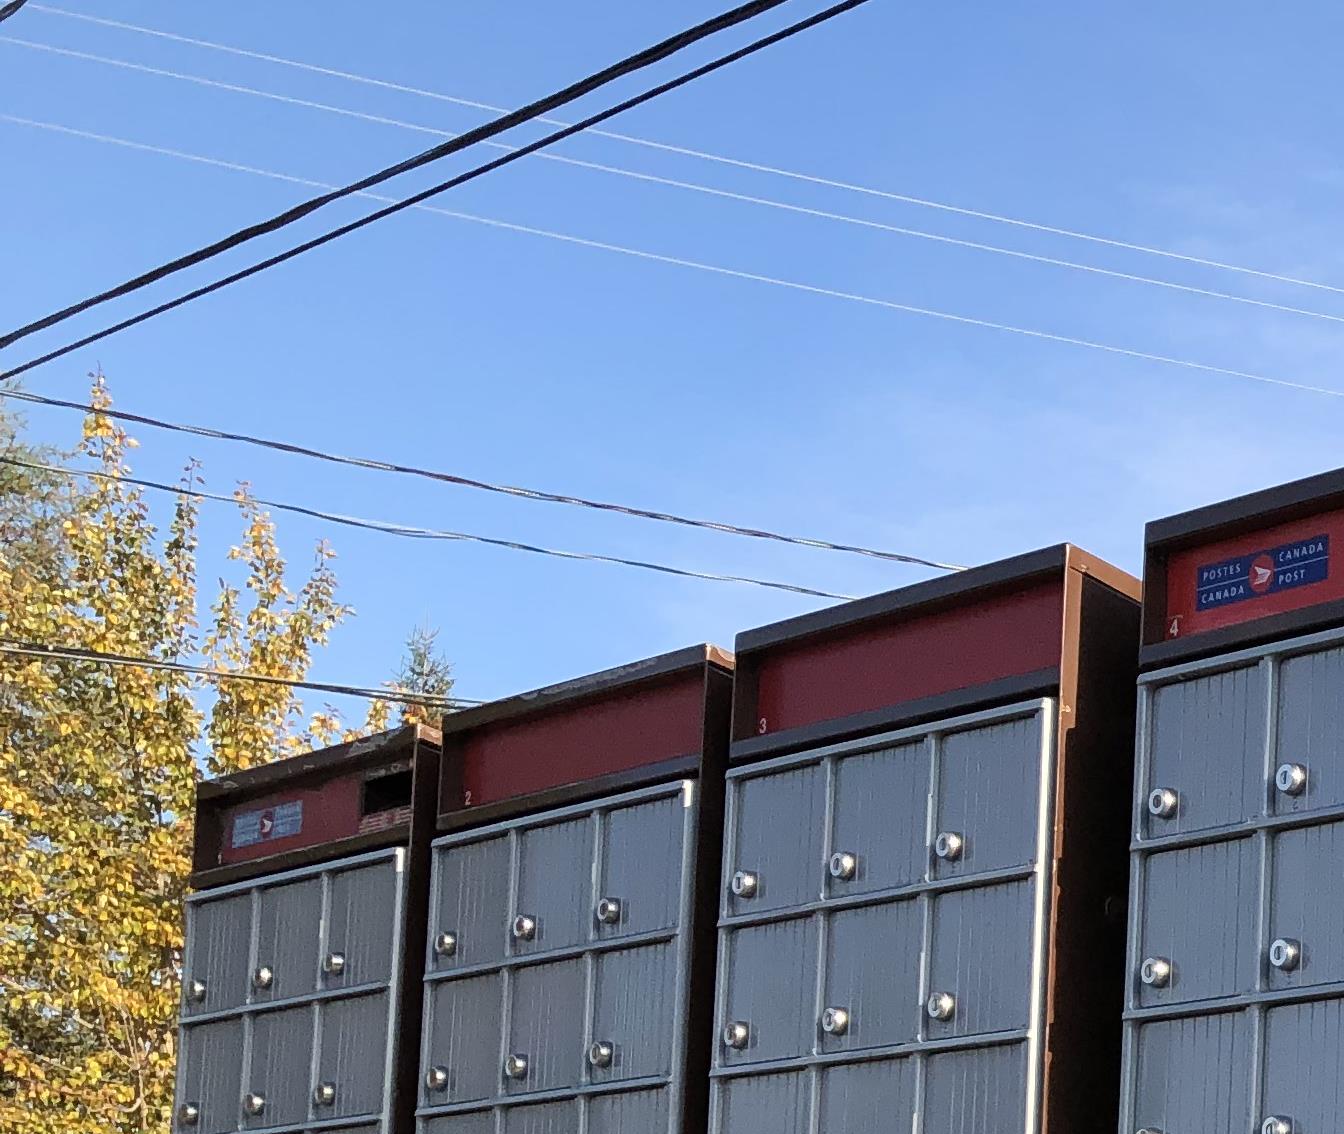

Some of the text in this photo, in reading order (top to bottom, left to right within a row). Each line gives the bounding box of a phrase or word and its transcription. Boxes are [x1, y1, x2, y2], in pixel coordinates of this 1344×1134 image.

[1278, 541, 1324, 562] CANADA
[1202, 563, 1241, 582] POSTES
[1278, 568, 1306, 585] POST
[1201, 584, 1245, 604] CANADA
[1169, 618, 1179, 637] 4
[758, 717, 767, 733] 3
[464, 790, 472, 806] 2
